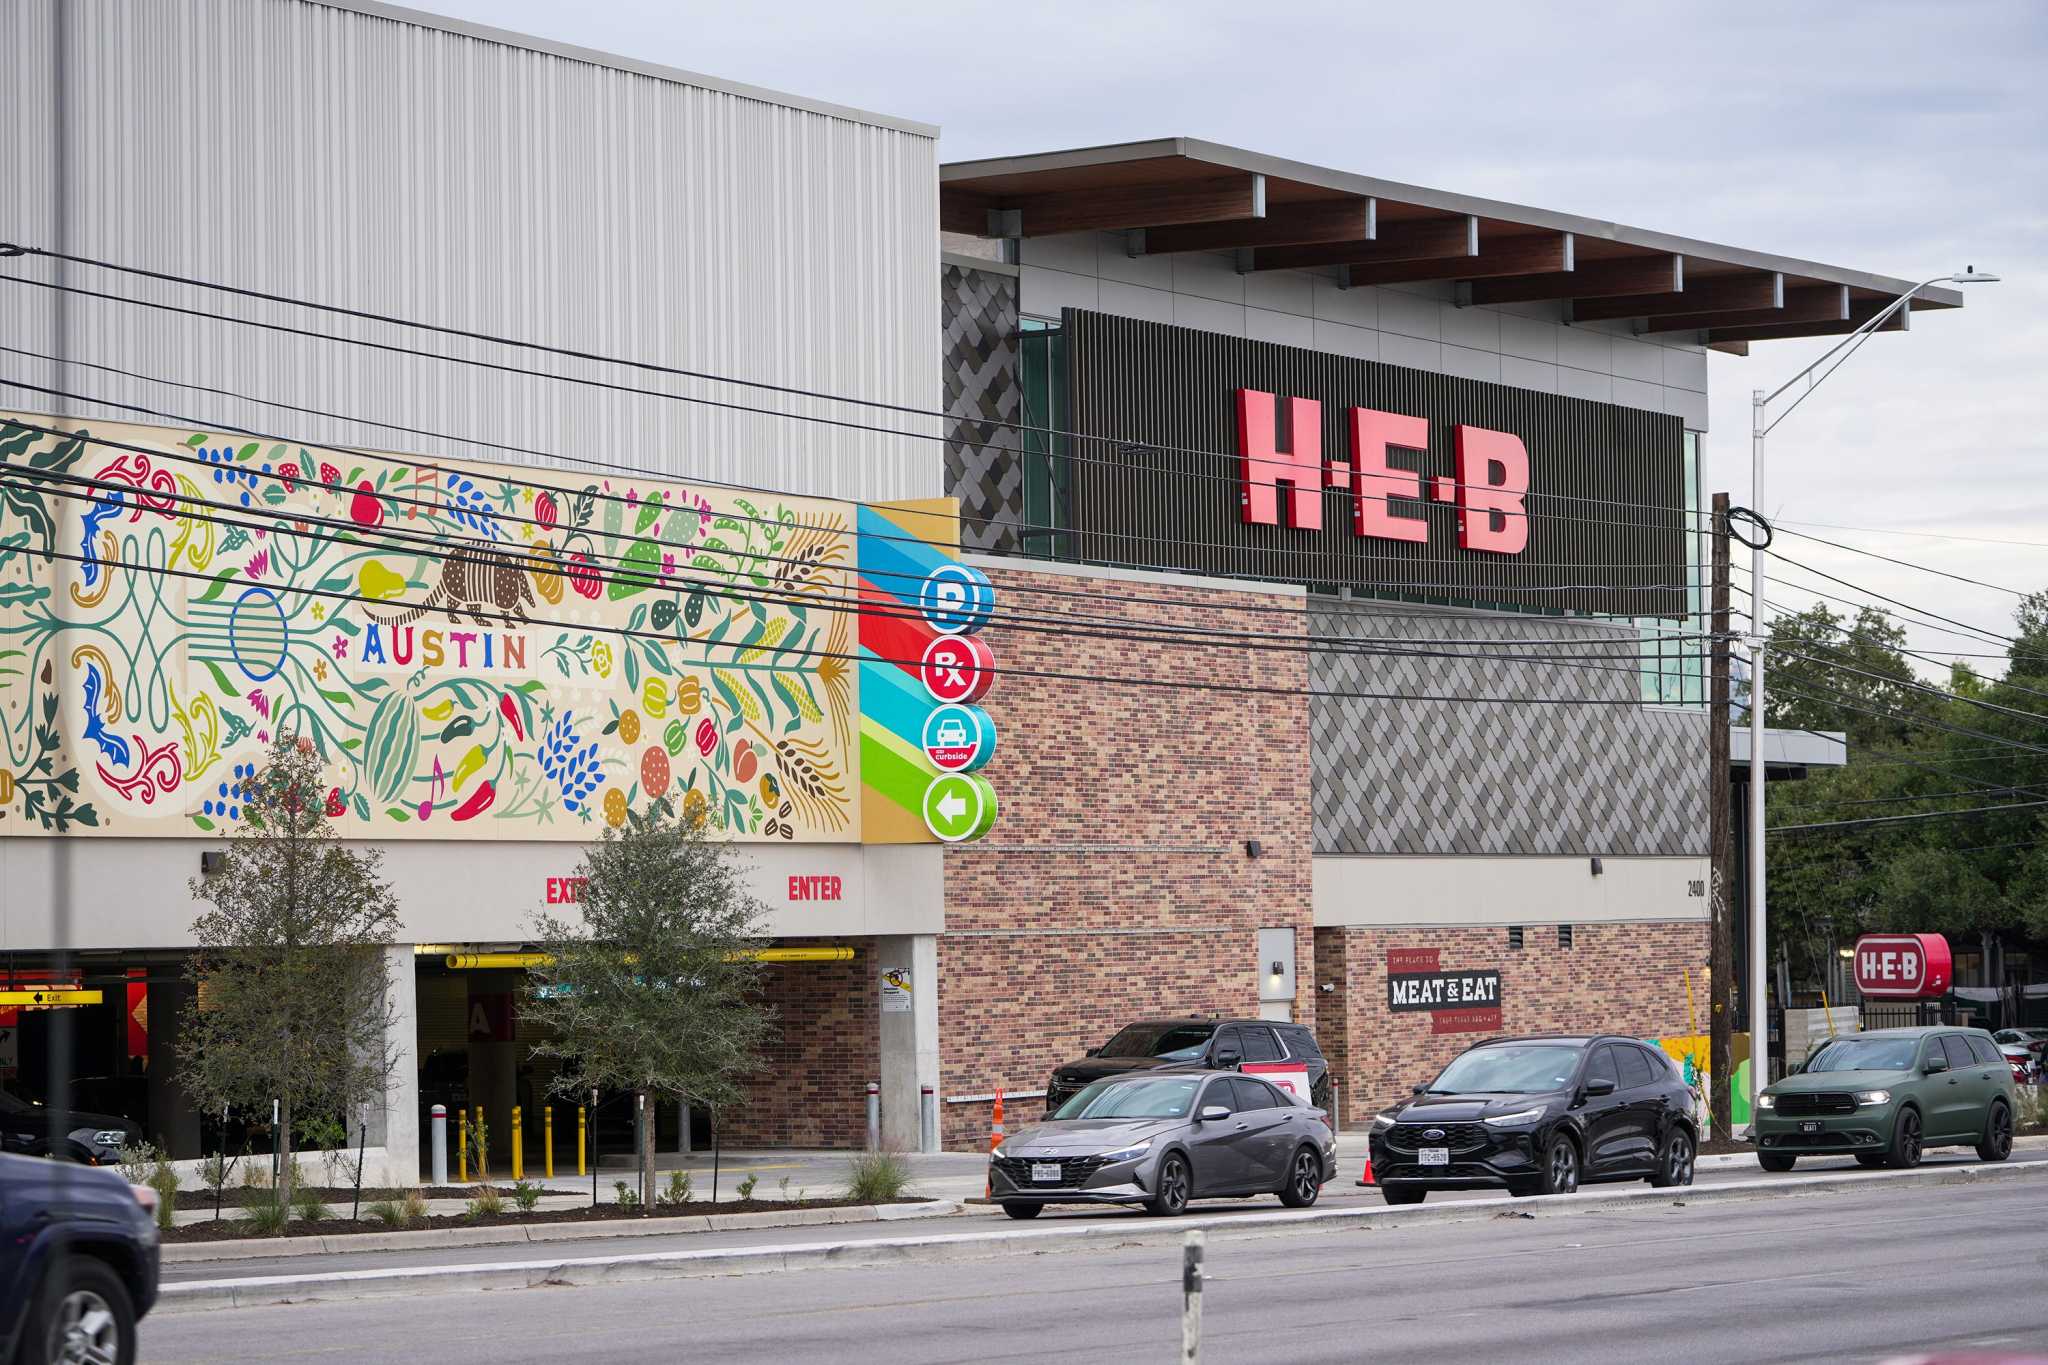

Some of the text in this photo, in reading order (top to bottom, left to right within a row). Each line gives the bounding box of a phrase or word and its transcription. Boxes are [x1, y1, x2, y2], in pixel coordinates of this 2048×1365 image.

[937, 583, 965, 622] P
[362, 623, 526, 669] AUSTIN
[935, 752, 968, 760] curbside
[788, 876, 842, 901] ENTER
[1688, 880, 1705, 897] 2400
[47, 994, 62, 1002] Exit
[1392, 976, 1497, 1005] MEAT & EAT
[469, 1002, 491, 1034] A
